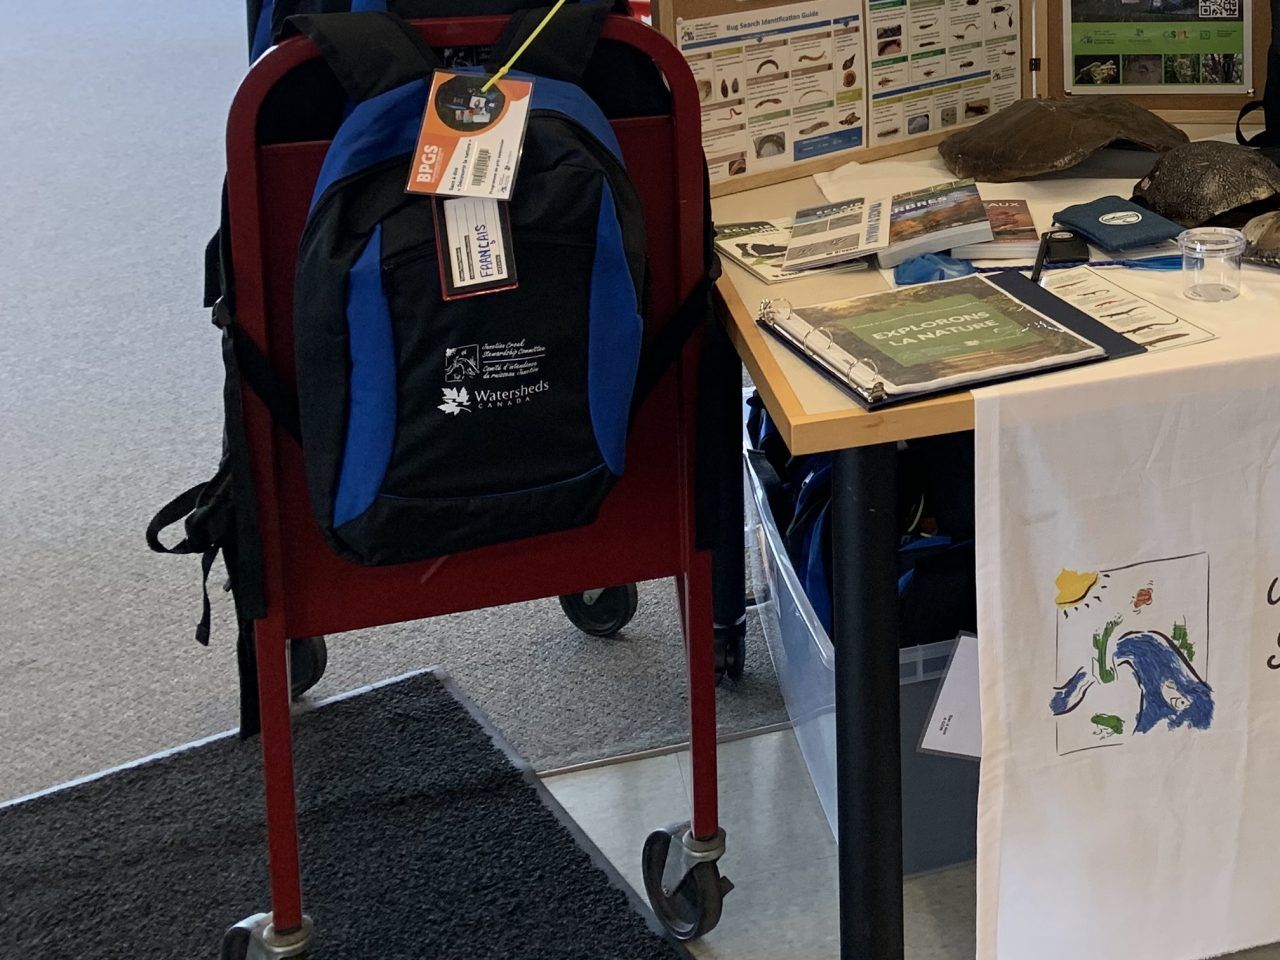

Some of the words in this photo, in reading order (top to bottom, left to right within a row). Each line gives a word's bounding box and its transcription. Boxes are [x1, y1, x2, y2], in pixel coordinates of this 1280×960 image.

[726, 24, 739, 32] Bug
[739, 20, 760, 30] Search
[761, 14, 800, 26] Identification
[801, 10, 819, 18] Guide
[417, 144, 439, 183] BPGS
[475, 224, 496, 278] FRANÇAIS
[872, 311, 990, 340] EXPLORONS
[889, 336, 917, 346] LA
[917, 319, 999, 341] NATURE
[475, 380, 549, 402] Watersheds
[478, 396, 530, 409] CANADA
